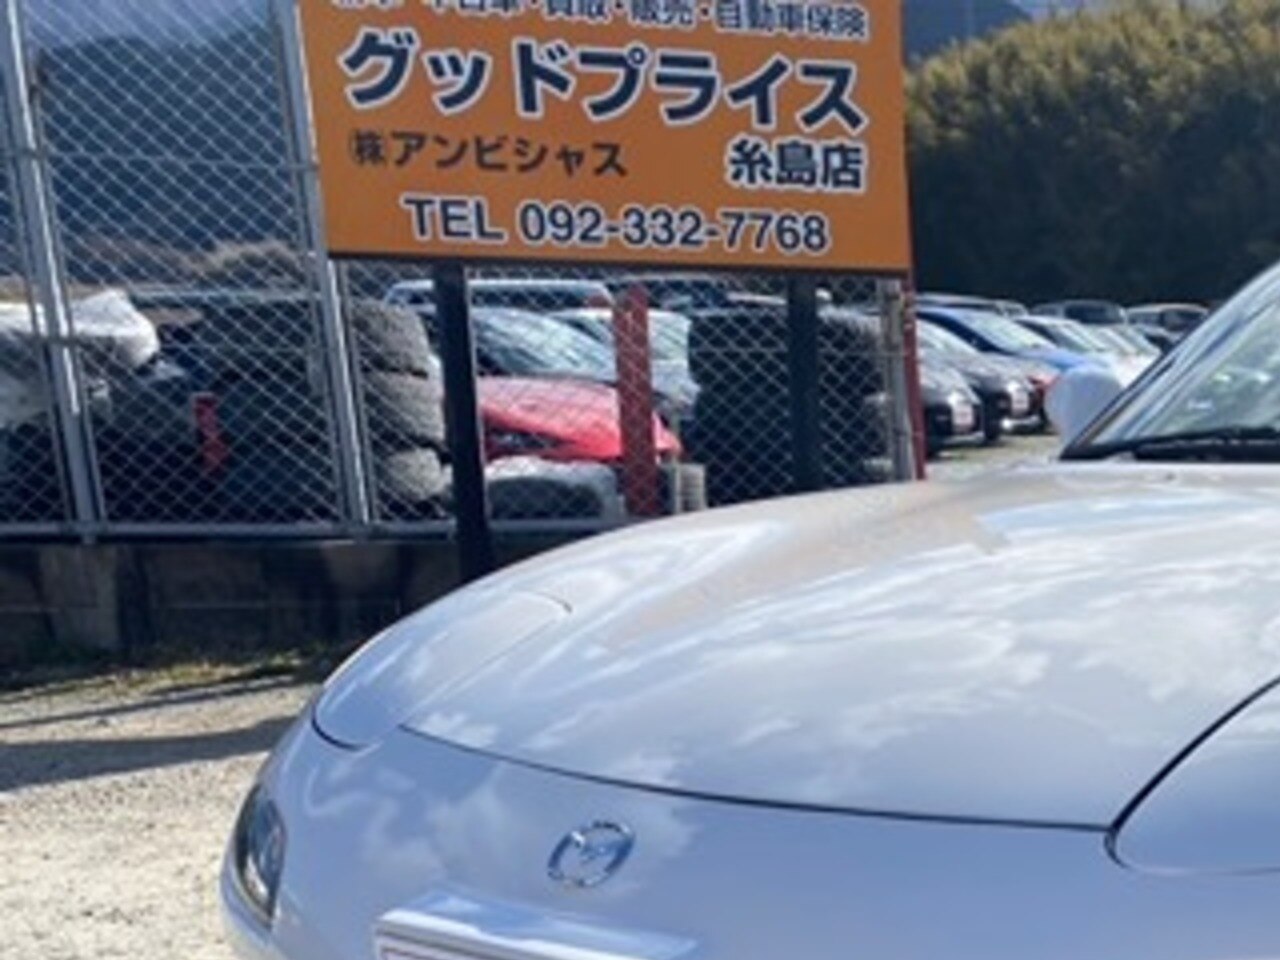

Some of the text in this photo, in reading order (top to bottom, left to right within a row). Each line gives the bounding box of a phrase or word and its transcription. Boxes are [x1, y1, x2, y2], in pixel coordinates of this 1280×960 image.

[340, 28, 868, 132] グッドプライス
[726, 139, 865, 191] 糸島店
[403, 196, 829, 253] TEL 092-332-7768
